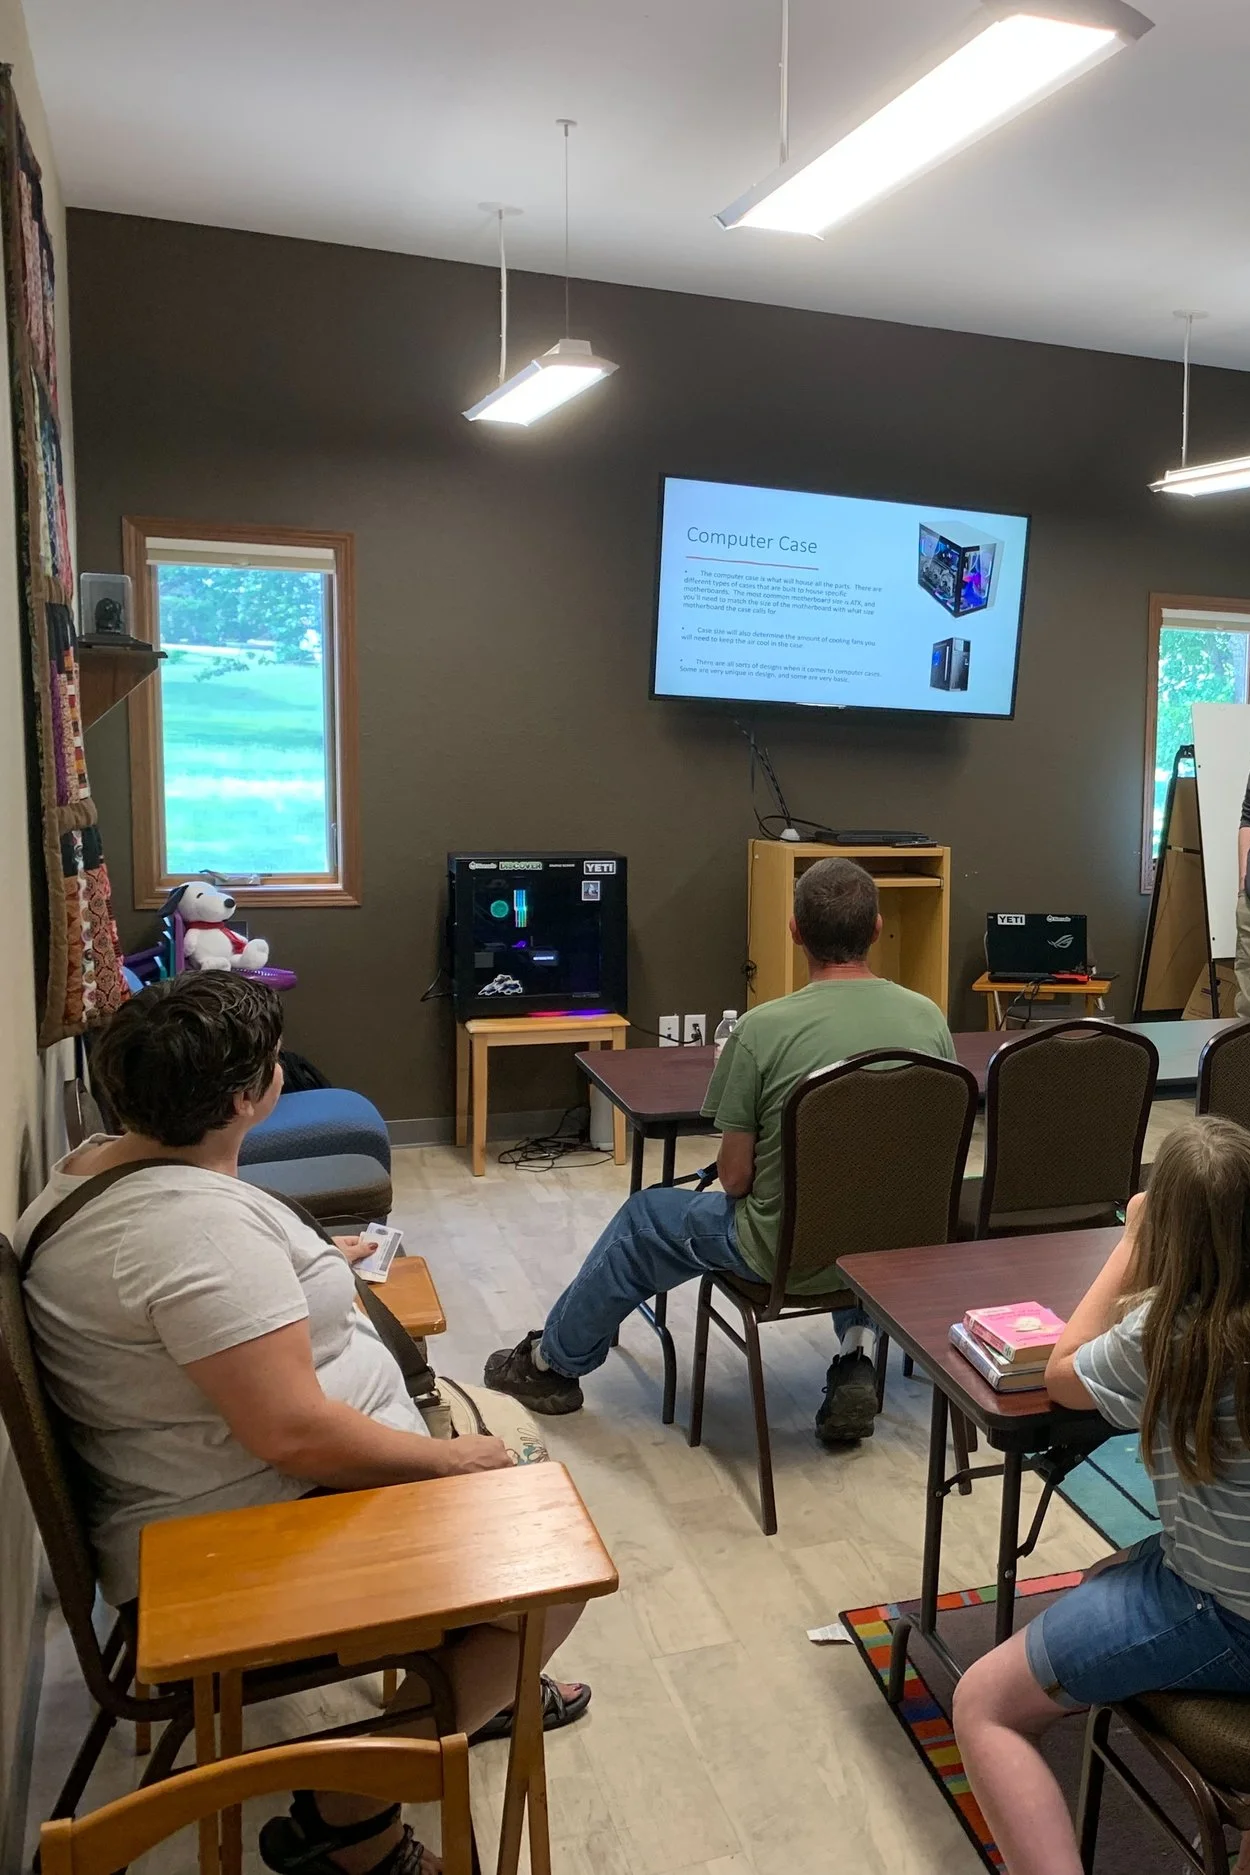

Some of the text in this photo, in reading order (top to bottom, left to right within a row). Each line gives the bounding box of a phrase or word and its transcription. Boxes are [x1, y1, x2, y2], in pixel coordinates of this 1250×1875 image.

[688, 527, 817, 553] Computer Case
[684, 577, 711, 585] different
[714, 573, 744, 581] computer
[791, 594, 831, 603] motherboard
[683, 602, 724, 611] motherboard
[792, 602, 831, 611] motherboard
[760, 663, 782, 671] designs
[586, 863, 613, 873] YETI
[999, 915, 1023, 923] YETI
